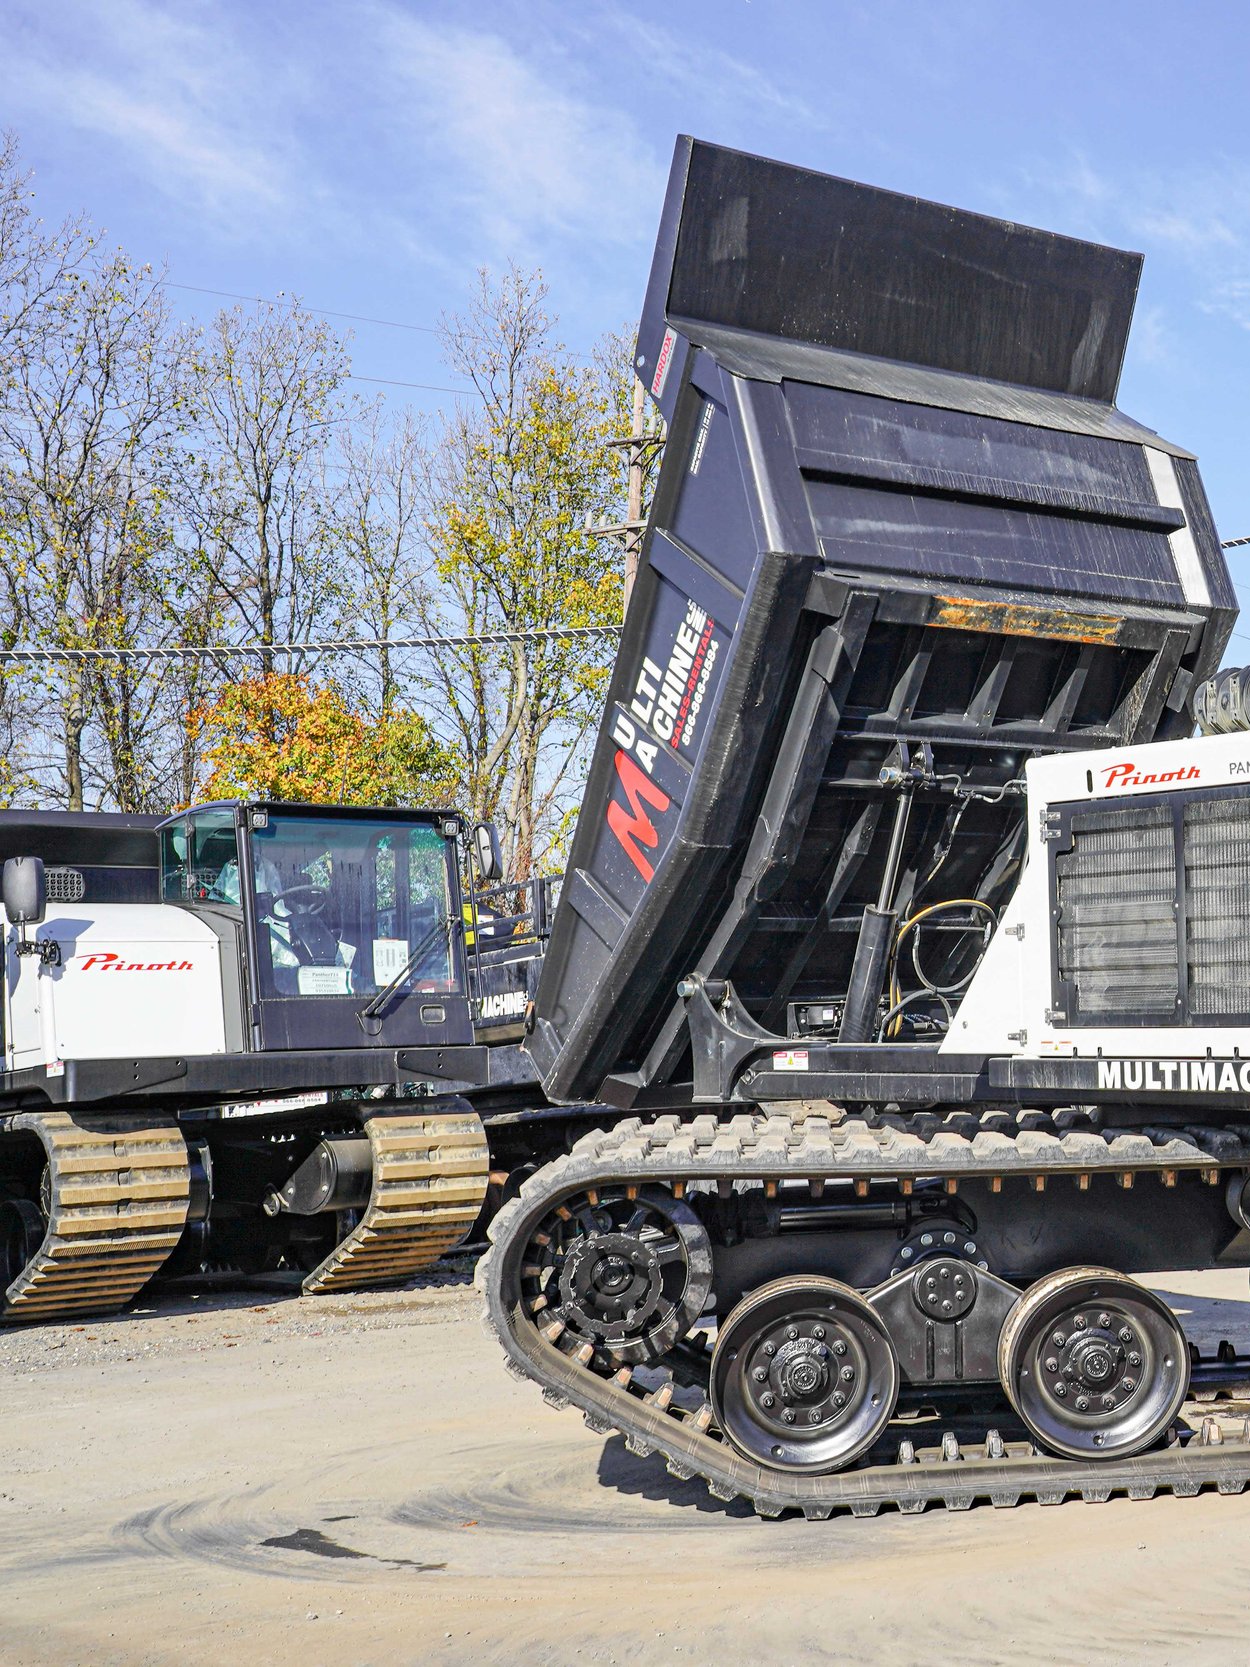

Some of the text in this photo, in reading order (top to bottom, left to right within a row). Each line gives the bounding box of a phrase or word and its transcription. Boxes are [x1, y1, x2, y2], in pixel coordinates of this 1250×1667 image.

[653, 334, 672, 393] HARDOX
[681, 639, 720, 746] 866-866-8584
[1100, 763, 1200, 788] Prinoth
[76, 953, 193, 970] Prinoth
